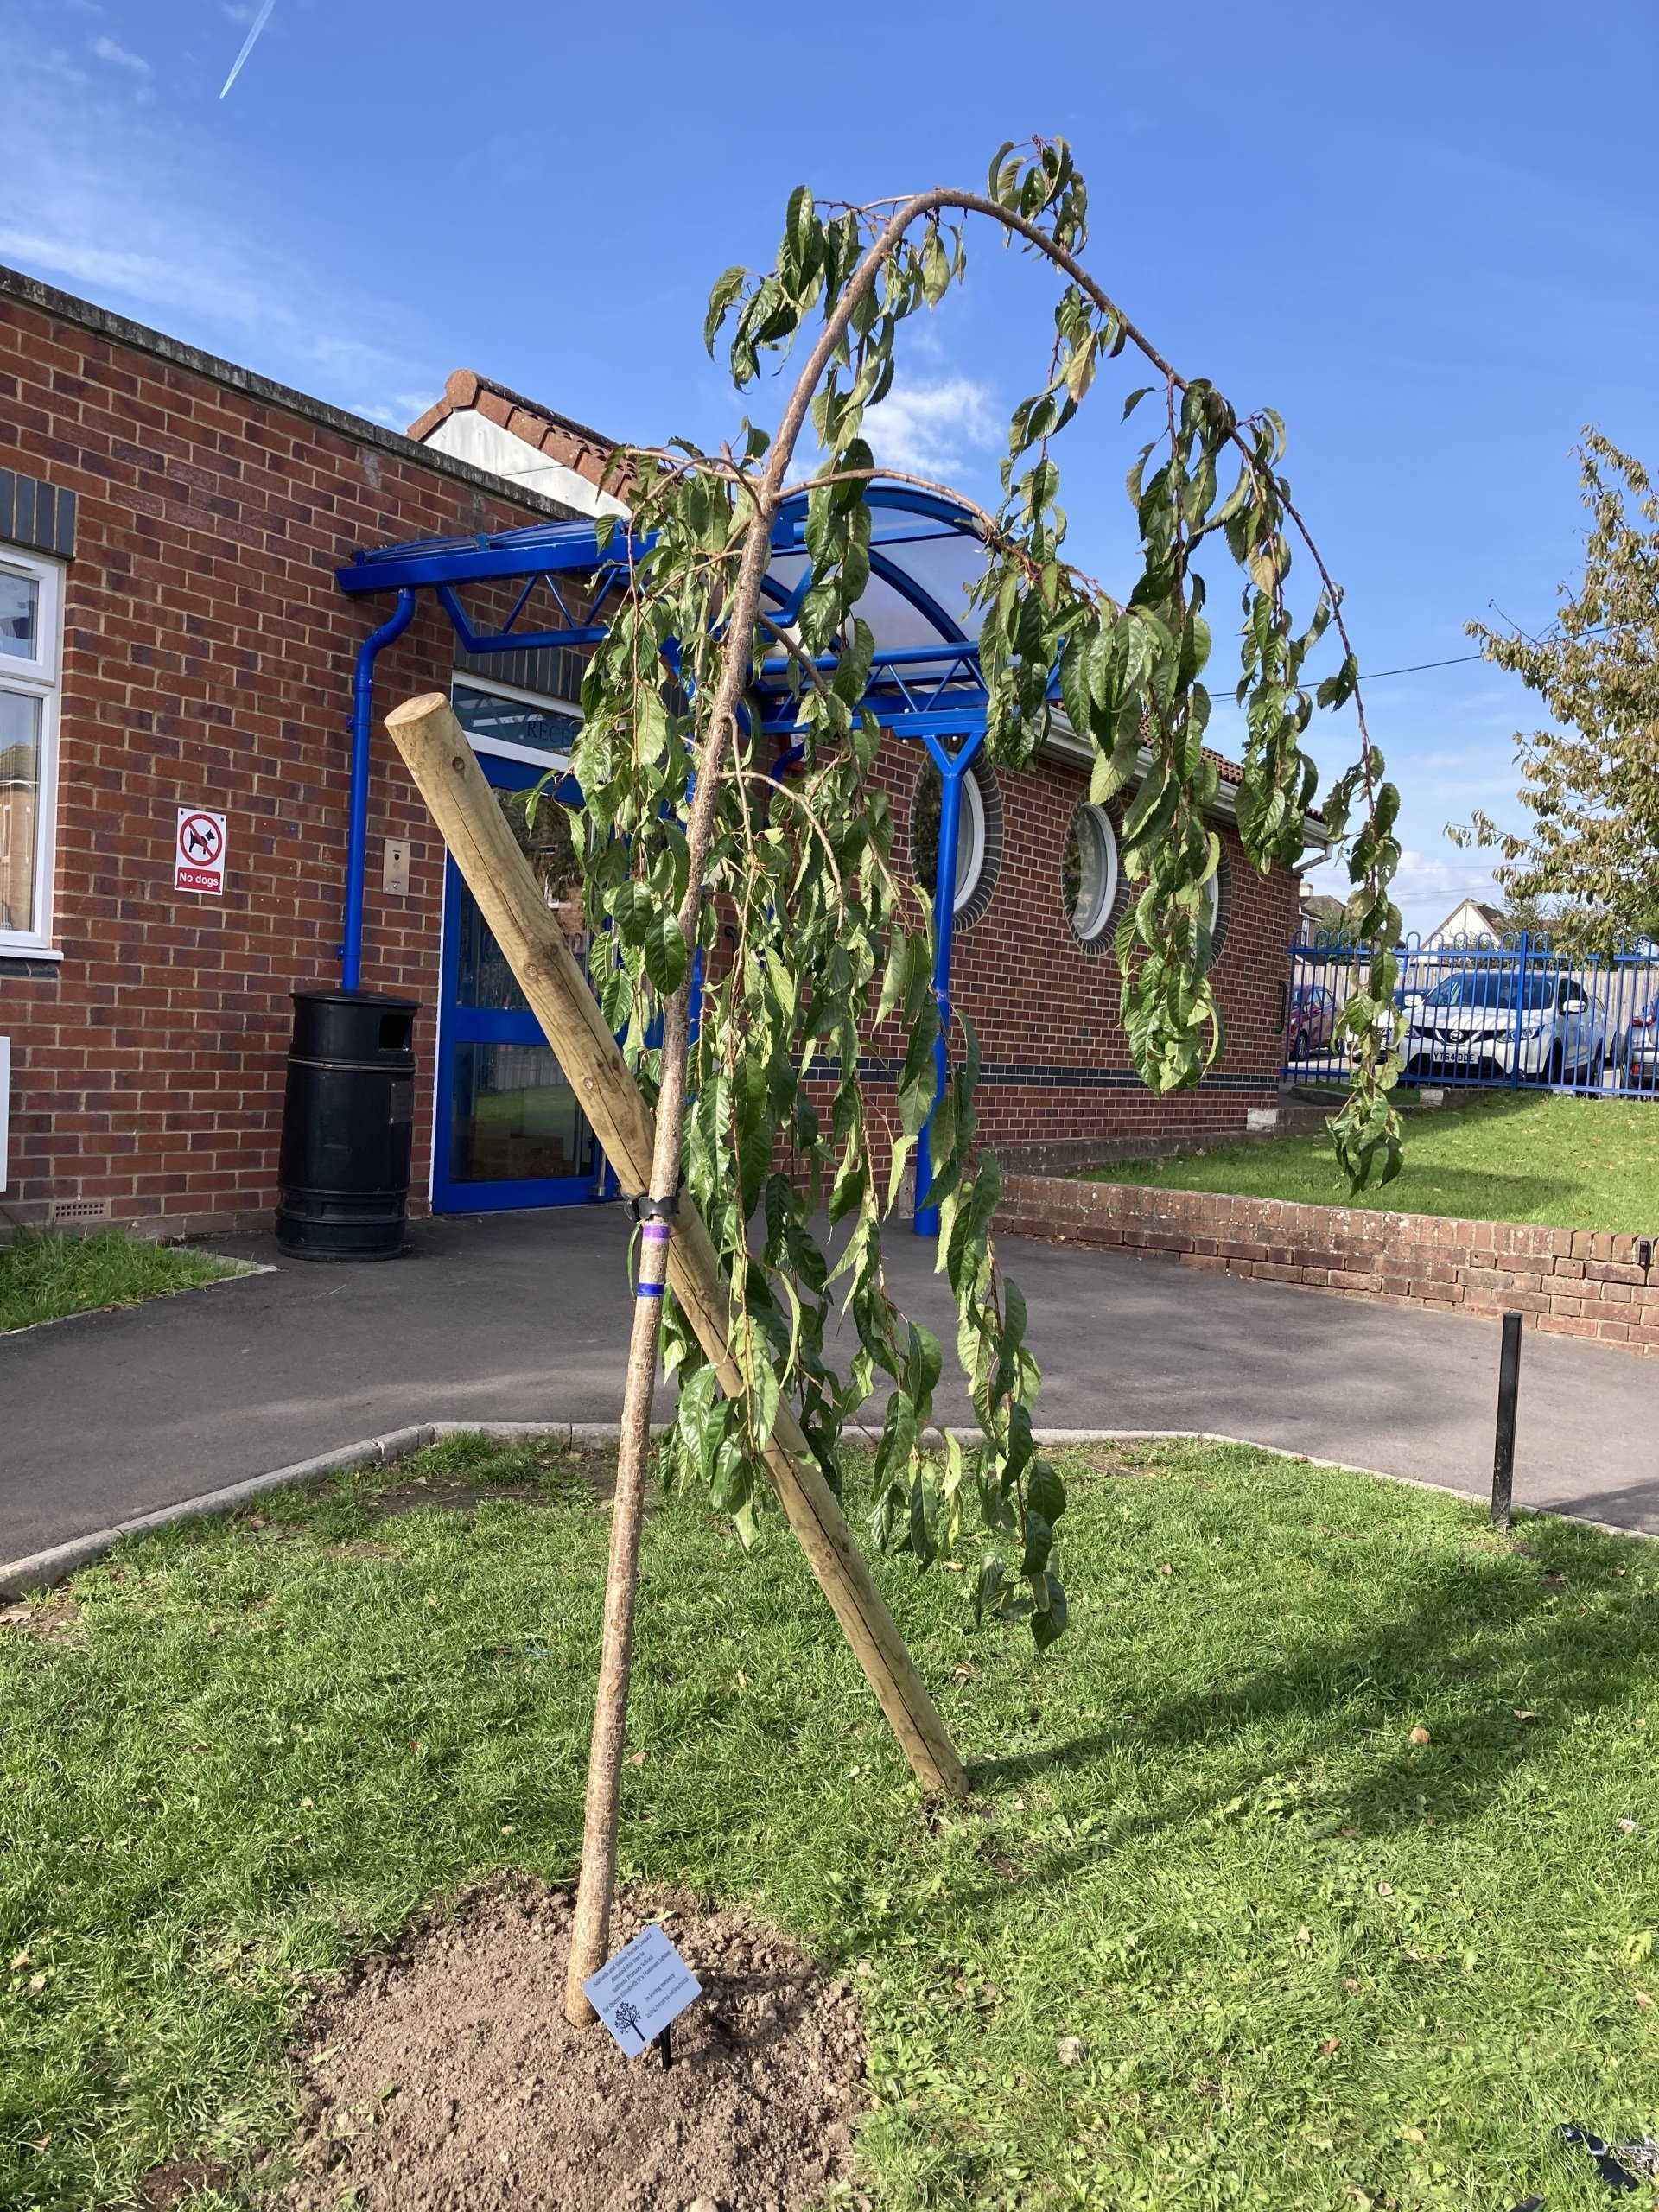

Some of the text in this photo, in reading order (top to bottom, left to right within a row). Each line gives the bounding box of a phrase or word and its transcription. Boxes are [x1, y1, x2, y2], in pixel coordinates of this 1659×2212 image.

[179, 872, 219, 887] No dogs
[627, 1945, 639, 1956] Parish
[639, 1933, 652, 1947] Council
[626, 1961, 634, 1969] this
[626, 1966, 642, 1980] Primary
[640, 1955, 654, 1967] School
[608, 1996, 621, 2009] Queen
[620, 1980, 639, 1998] Elizabeth
[649, 1986, 663, 1998] loving
